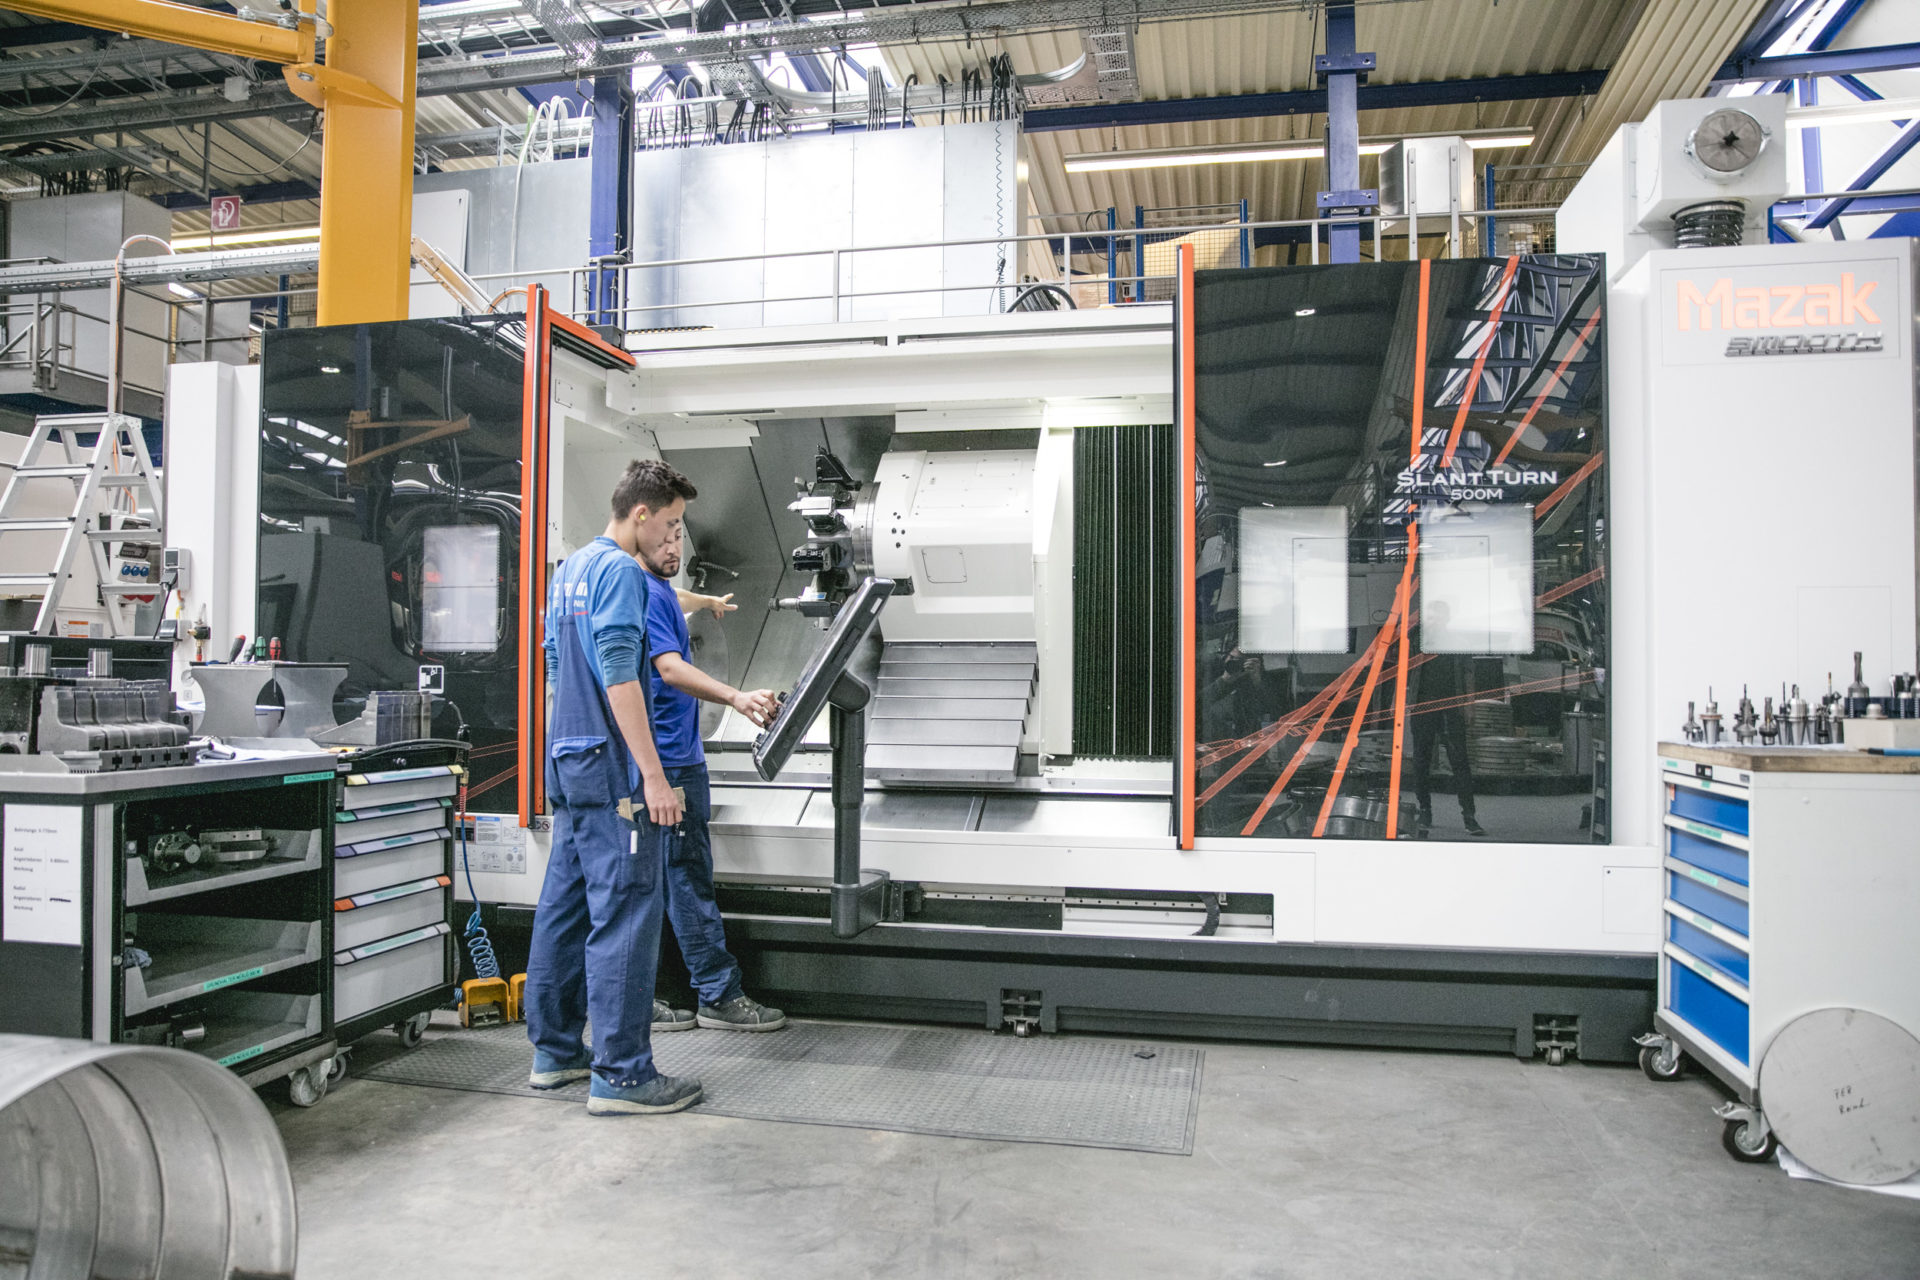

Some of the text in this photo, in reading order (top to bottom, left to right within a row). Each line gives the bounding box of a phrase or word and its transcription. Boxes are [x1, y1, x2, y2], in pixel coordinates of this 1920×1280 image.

[1676, 272, 1882, 331] Mazak
[1729, 332, 1883, 349] SMOOTH
[1397, 469, 1557, 487] SLANT TURN
[1450, 488, 1503, 501] 500M
